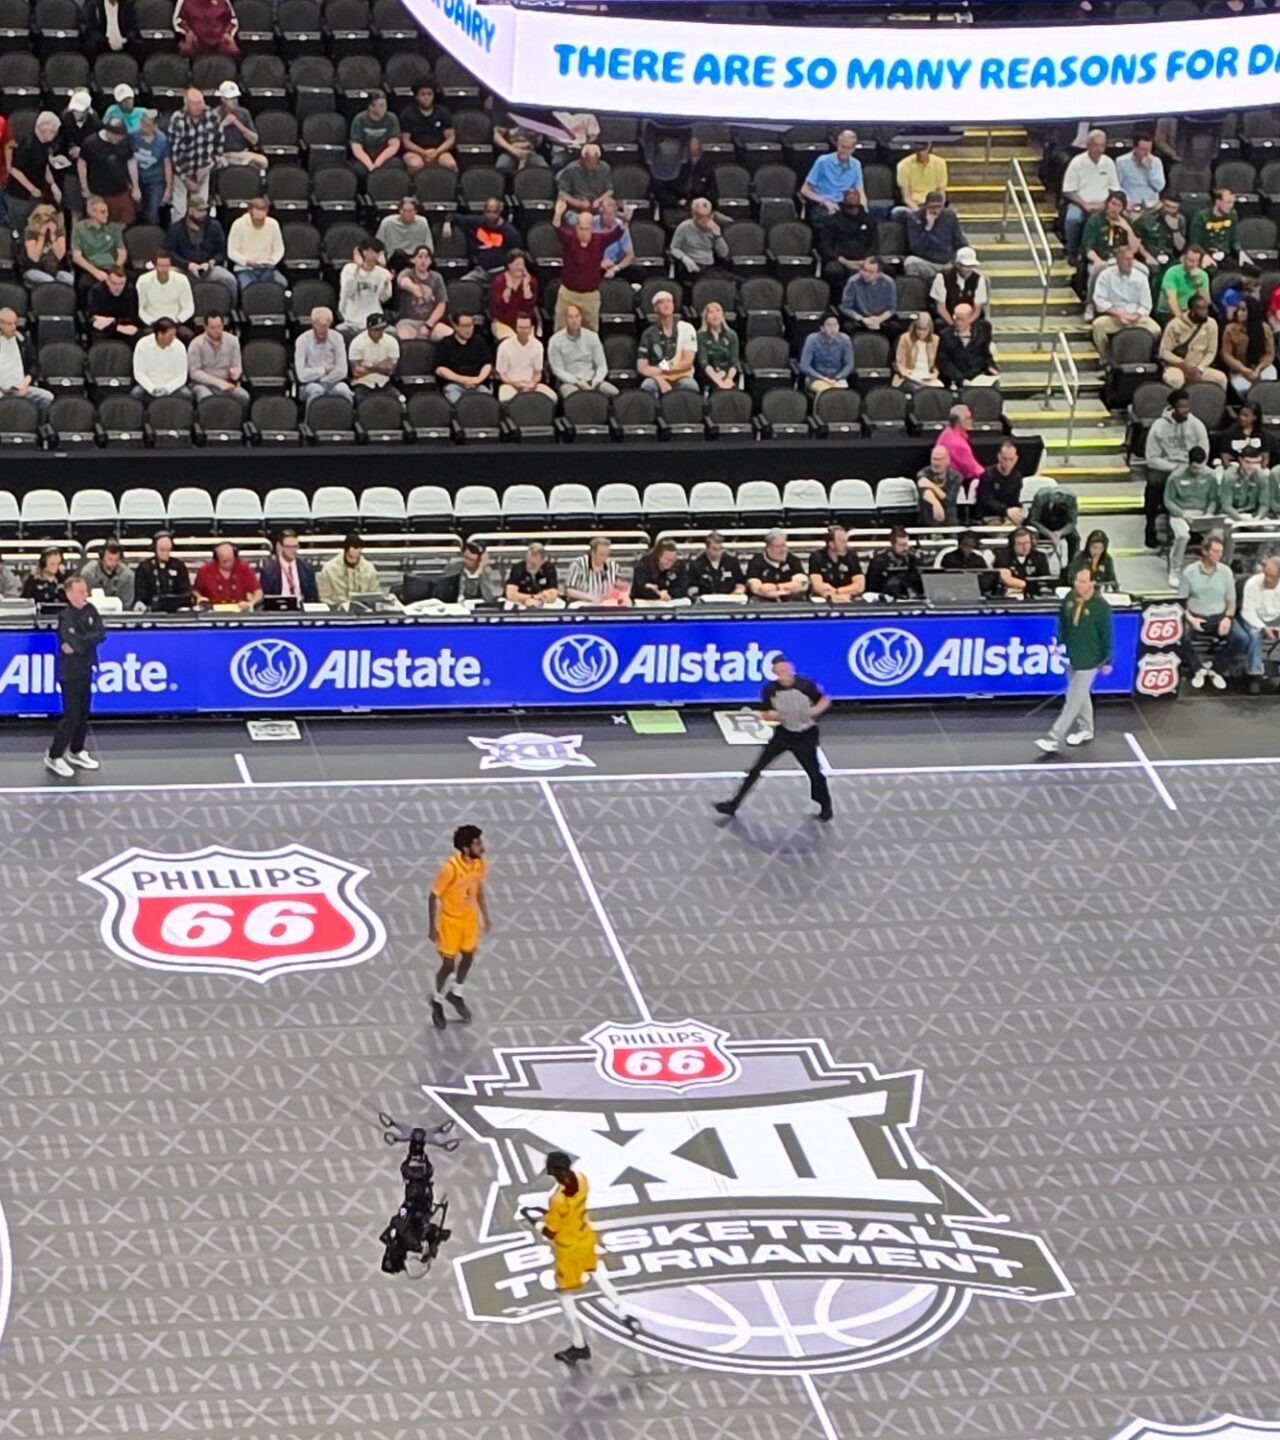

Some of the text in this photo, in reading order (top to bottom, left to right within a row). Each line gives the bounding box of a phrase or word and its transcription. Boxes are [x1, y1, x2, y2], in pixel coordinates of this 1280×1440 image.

[554, 44, 685, 83] THERE
[693, 54, 776, 87] ARE
[784, 57, 837, 89] SO
[847, 58, 971, 90] MANY
[980, 52, 1157, 90] REASONS
[1166, 46, 1239, 82] FOR
[1149, 621, 1176, 639] 66
[309, 648, 481, 689] Allstate
[924, 637, 1070, 677] Allstat
[1144, 670, 1171, 688] 66
[132, 866, 322, 890] PHILLIPS
[160, 900, 318, 948] 66
[609, 1031, 707, 1046] PHILLIPS
[625, 1049, 707, 1077] 66
[503, 1219, 1000, 1273] BSKETBALL
